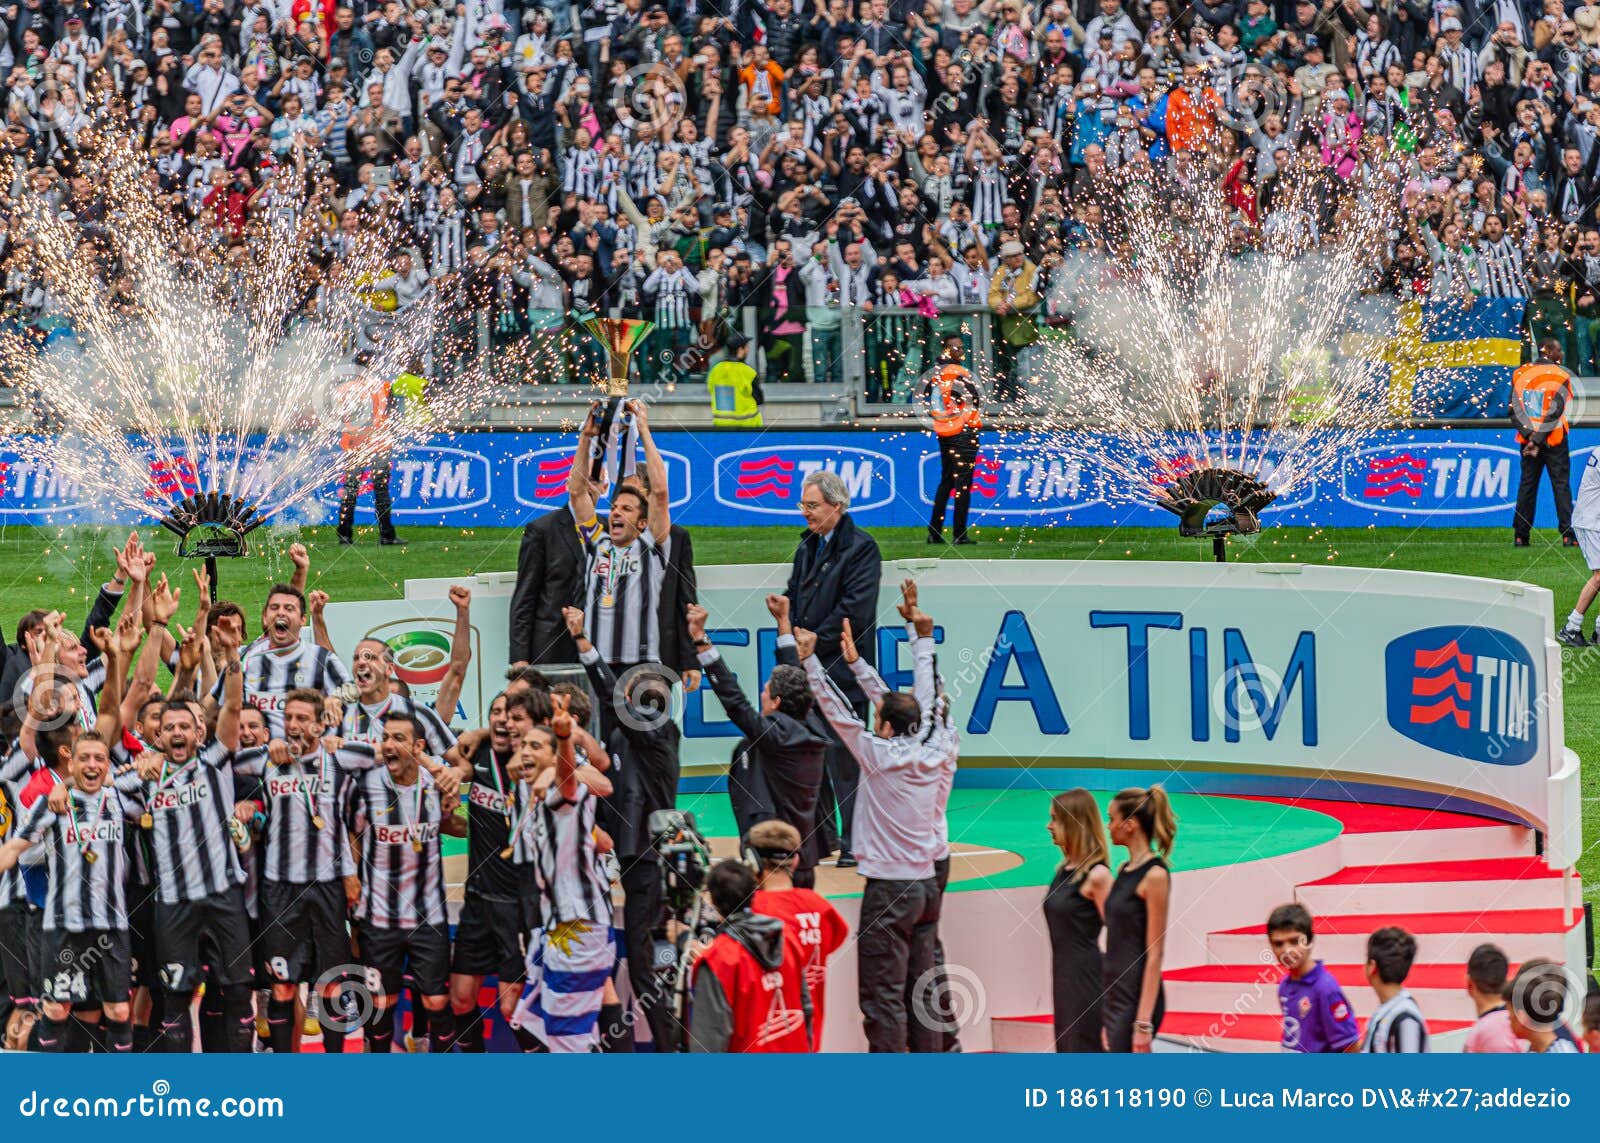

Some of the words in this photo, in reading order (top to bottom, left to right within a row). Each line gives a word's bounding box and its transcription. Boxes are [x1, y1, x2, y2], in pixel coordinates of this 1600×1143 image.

[399, 461, 470, 499] TIM
[1005, 460, 1081, 498] TIM
[1431, 458, 1510, 498] TIM
[967, 610, 1070, 735] A
[1089, 610, 1318, 747] TIM
[1476, 655, 1529, 742] TIM
[796, 911, 820, 929] TV
[54, 971, 87, 1000] 24
